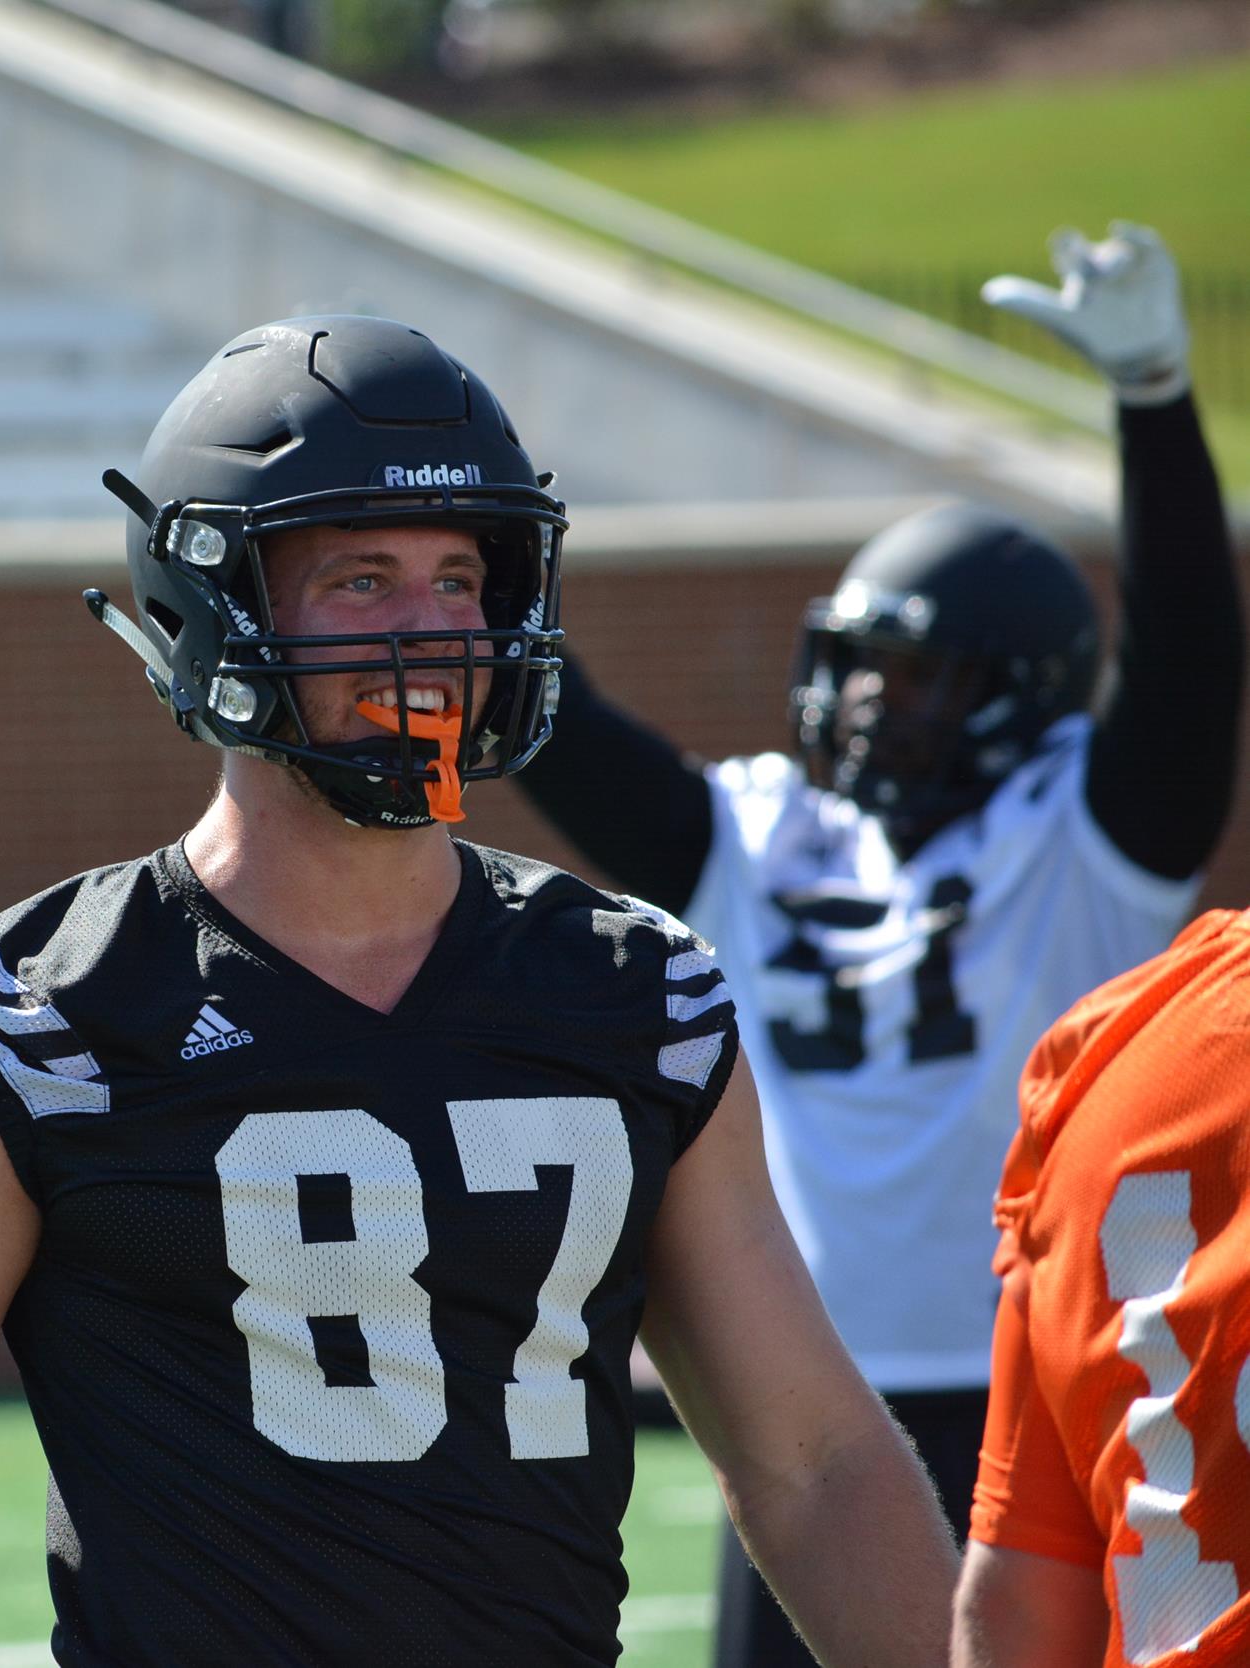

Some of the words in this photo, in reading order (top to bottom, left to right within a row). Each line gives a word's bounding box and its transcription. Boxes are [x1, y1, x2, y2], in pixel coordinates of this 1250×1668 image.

[384, 464, 482, 487] Riddell
[180, 1029, 254, 1060] adidas
[214, 1096, 634, 1462] 87
